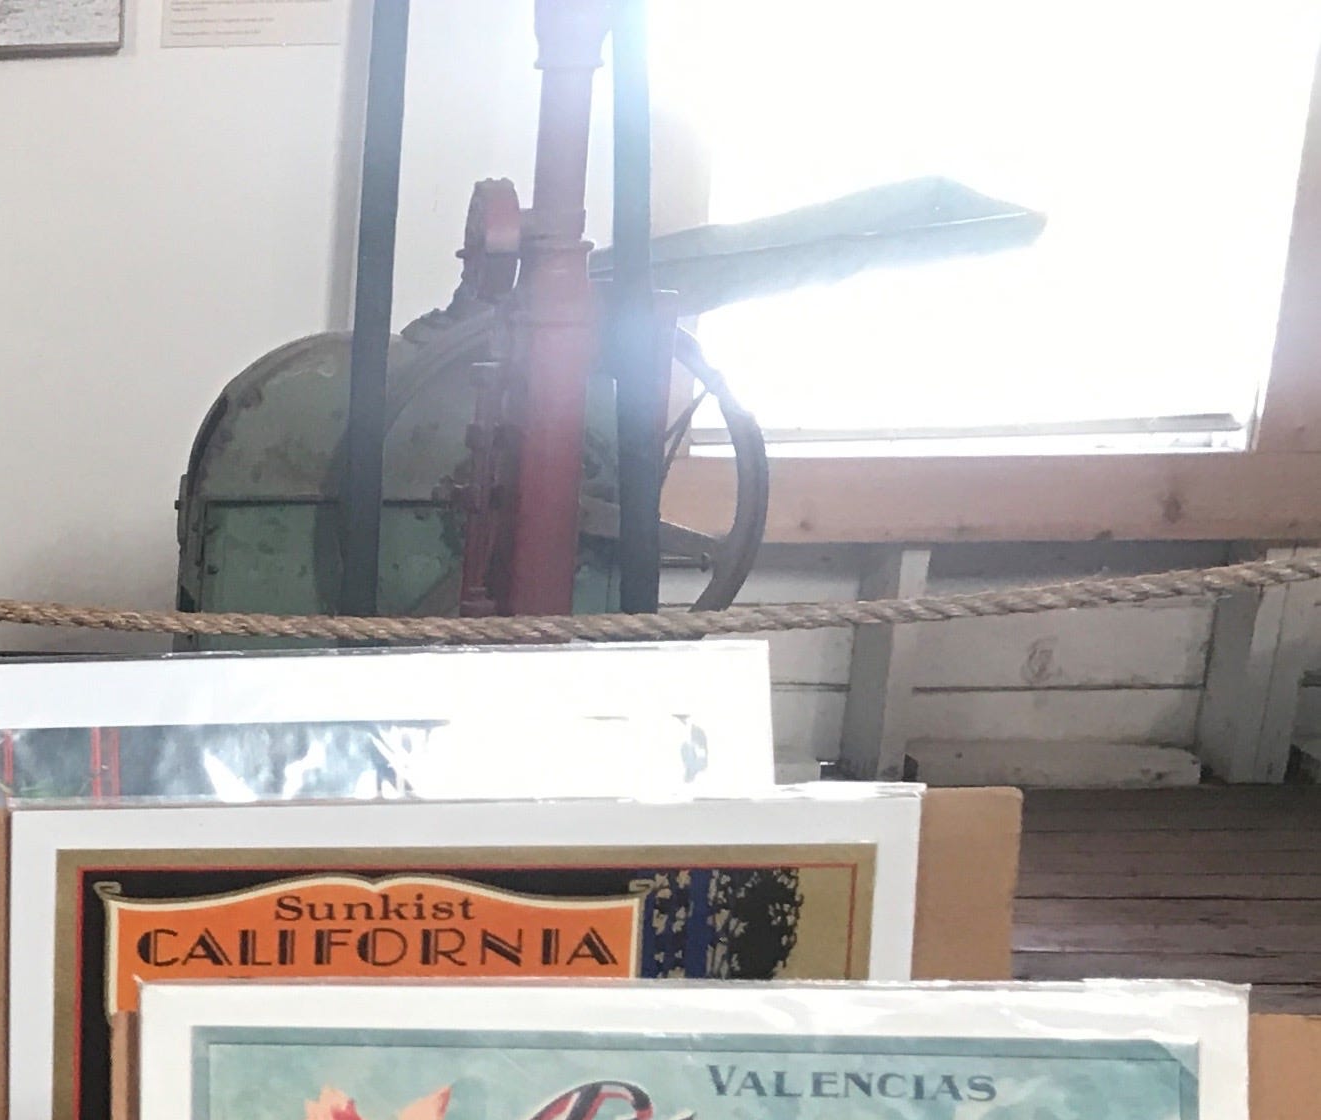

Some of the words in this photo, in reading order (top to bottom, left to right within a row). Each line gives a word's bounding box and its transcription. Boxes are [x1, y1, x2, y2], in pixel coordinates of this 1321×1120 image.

[273, 889, 474, 925] Sunkist
[135, 927, 623, 969] CALIFORNIA
[707, 1065, 997, 1104] VALENCIAS
